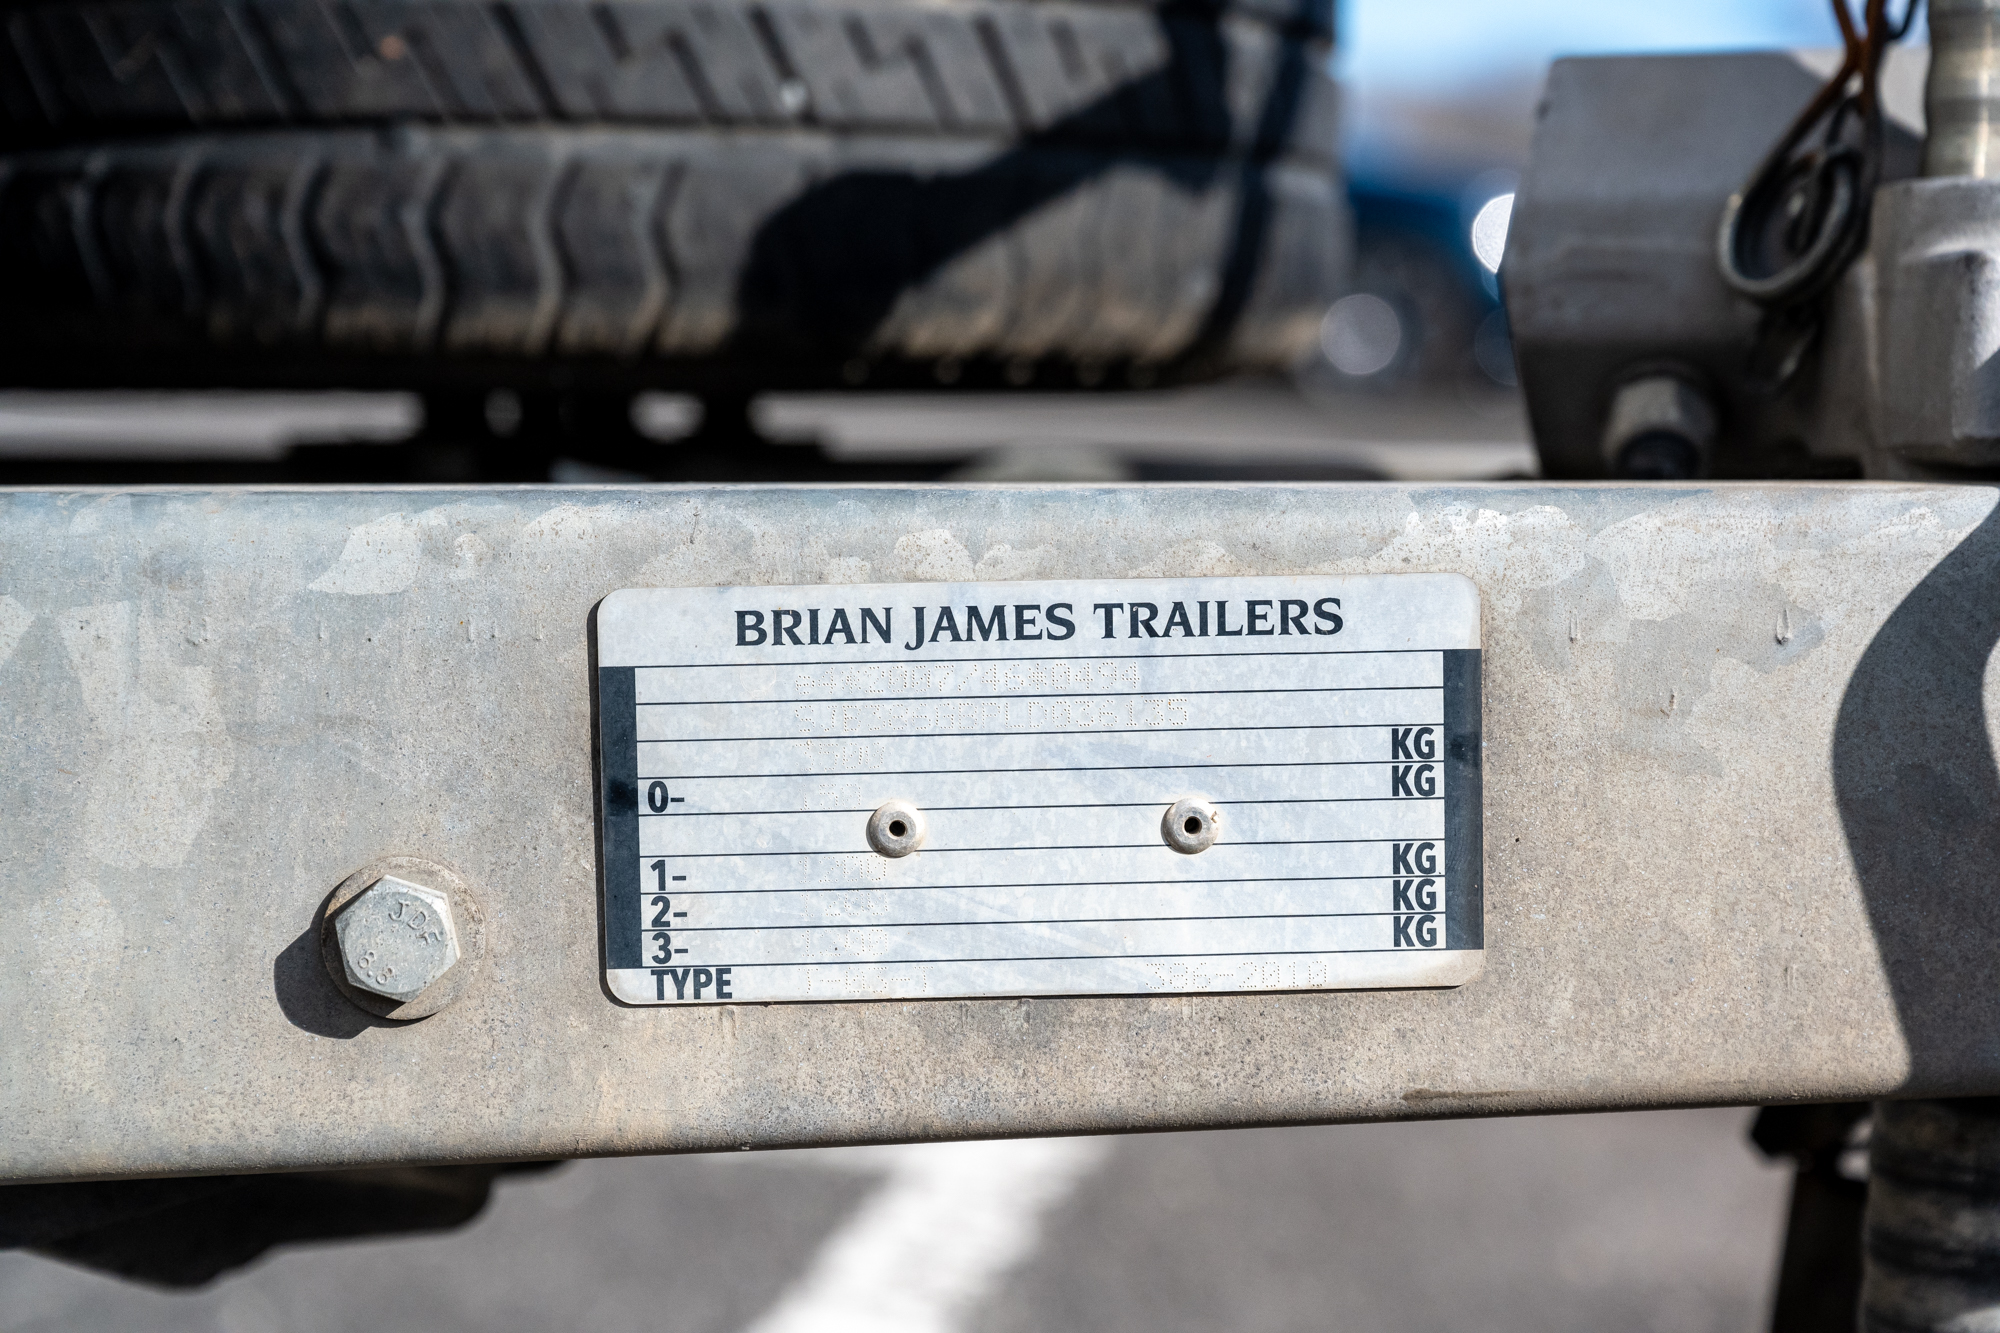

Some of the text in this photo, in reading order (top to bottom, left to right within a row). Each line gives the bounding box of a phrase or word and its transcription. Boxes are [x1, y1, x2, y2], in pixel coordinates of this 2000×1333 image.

[735, 597, 1344, 651] BRIAN JAMES TRAILERS
[794, 698, 1188, 733] SJB386GBPLD036135
[794, 726, 1436, 771] 3500 KG
[798, 783, 863, 811] 150
[1391, 764, 1437, 798] KG
[798, 855, 887, 884] 1200
[1392, 842, 1437, 875] KG
[800, 888, 889, 917] 1200
[1392, 878, 1437, 912] KG
[801, 928, 889, 957] 1200
[1393, 914, 1438, 948] KG
[650, 967, 733, 1001] TYPE
[1145, 960, 1327, 990] 386-2010
